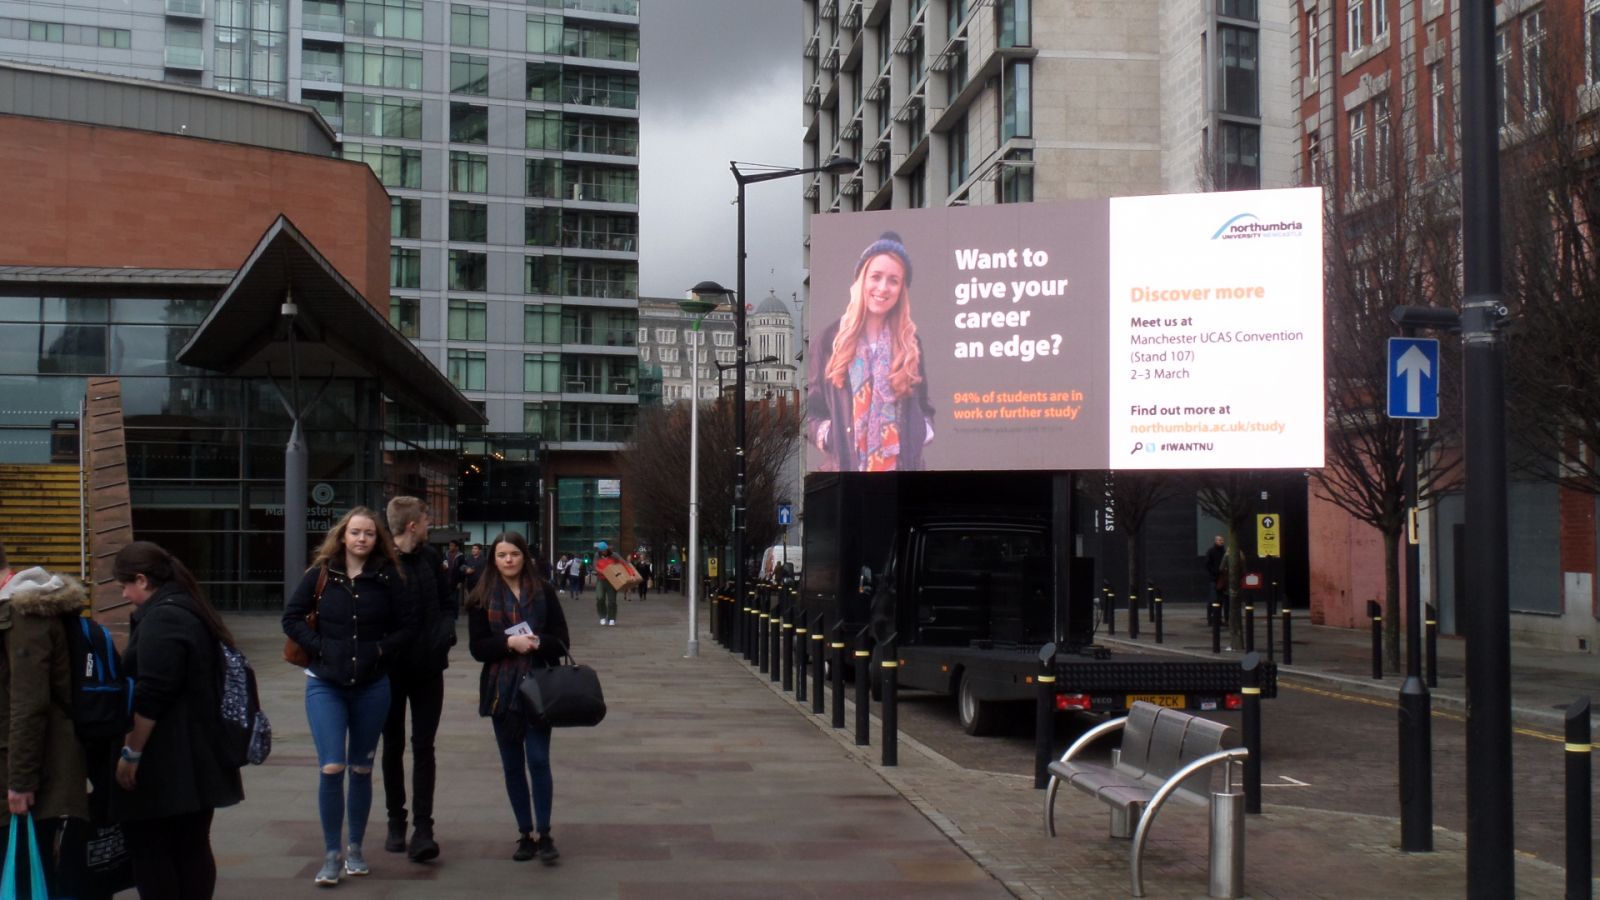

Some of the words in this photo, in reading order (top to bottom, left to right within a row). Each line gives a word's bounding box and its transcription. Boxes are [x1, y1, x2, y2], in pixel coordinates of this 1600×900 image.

[1230, 221, 1303, 233] northumbria
[1222, 232, 1261, 240] UNIVERSITY
[955, 249, 1017, 270] Want
[1022, 248, 1048, 267] to
[955, 277, 1007, 305] give
[1011, 279, 1068, 303] your
[1130, 286, 1211, 303] Discover
[1215, 286, 1265, 300] more
[955, 310, 1031, 328] career
[1130, 317, 1161, 328] Meet
[1164, 318, 1178, 327] us
[1181, 317, 1193, 326] at
[1130, 334, 1197, 345] Manchester
[1200, 332, 1232, 343] UCAS
[1234, 331, 1303, 342] Convention
[954, 341, 984, 358] an
[989, 334, 1063, 362] edge?
[1130, 351, 1167, 363] (Stand
[1171, 350, 1195, 362] 107)
[1154, 368, 1190, 379] March
[953, 391, 980, 404] 94%
[982, 391, 996, 403] of
[996, 390, 1048, 403] students
[1049, 392, 1070, 402] are
[1071, 390, 1083, 401] in
[953, 407, 983, 419] work
[985, 409, 998, 419] or
[1000, 406, 1042, 418] further
[1130, 405, 1157, 416] Find
[1160, 405, 1181, 416] out
[1184, 406, 1216, 416] more
[1219, 405, 1231, 415] at
[1130, 420, 1286, 434] northumbria.ac.uk/study
[1160, 442, 1214, 452] #IWANTNU
[265, 505, 335, 517] Maester
[1158, 695, 1179, 707] ZCK
